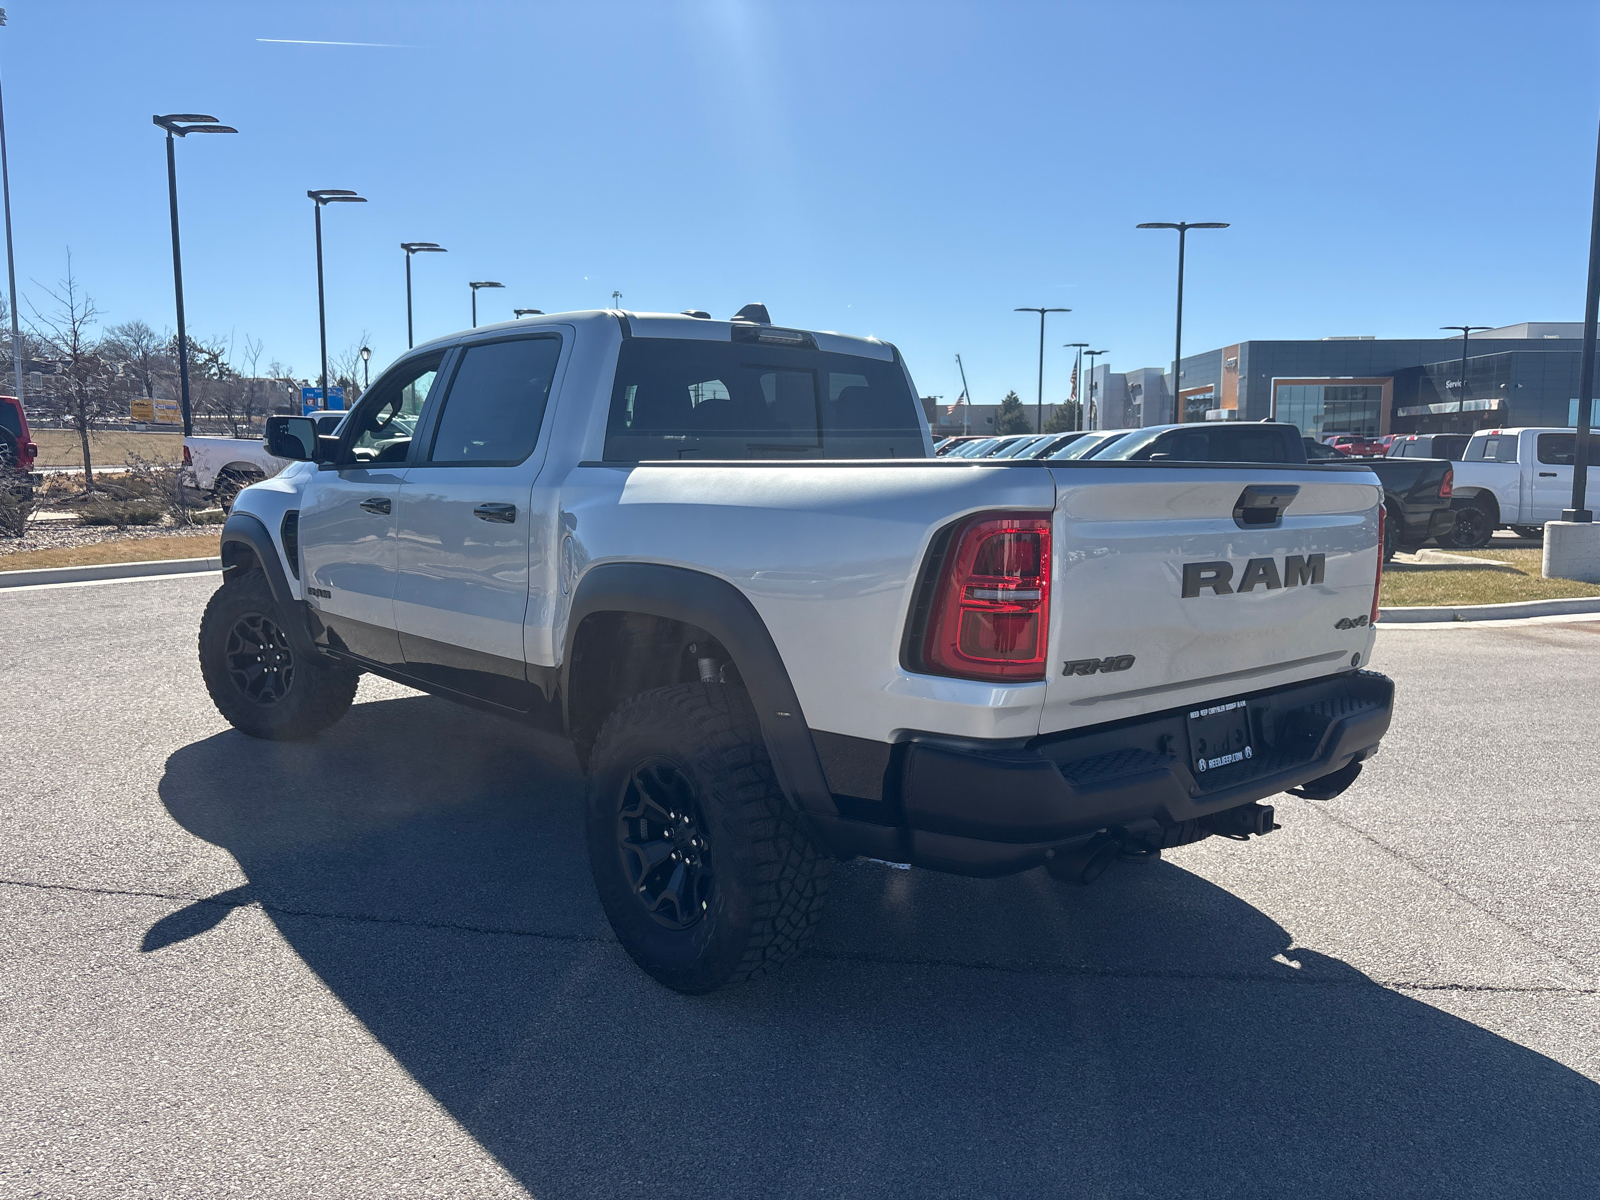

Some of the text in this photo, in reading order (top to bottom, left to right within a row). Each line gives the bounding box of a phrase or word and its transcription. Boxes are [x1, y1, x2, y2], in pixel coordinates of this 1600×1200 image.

[1181, 553, 1326, 598] RAM
[1062, 654, 1136, 676] RHO
[1208, 751, 1244, 769] REEDJEEP.COM
